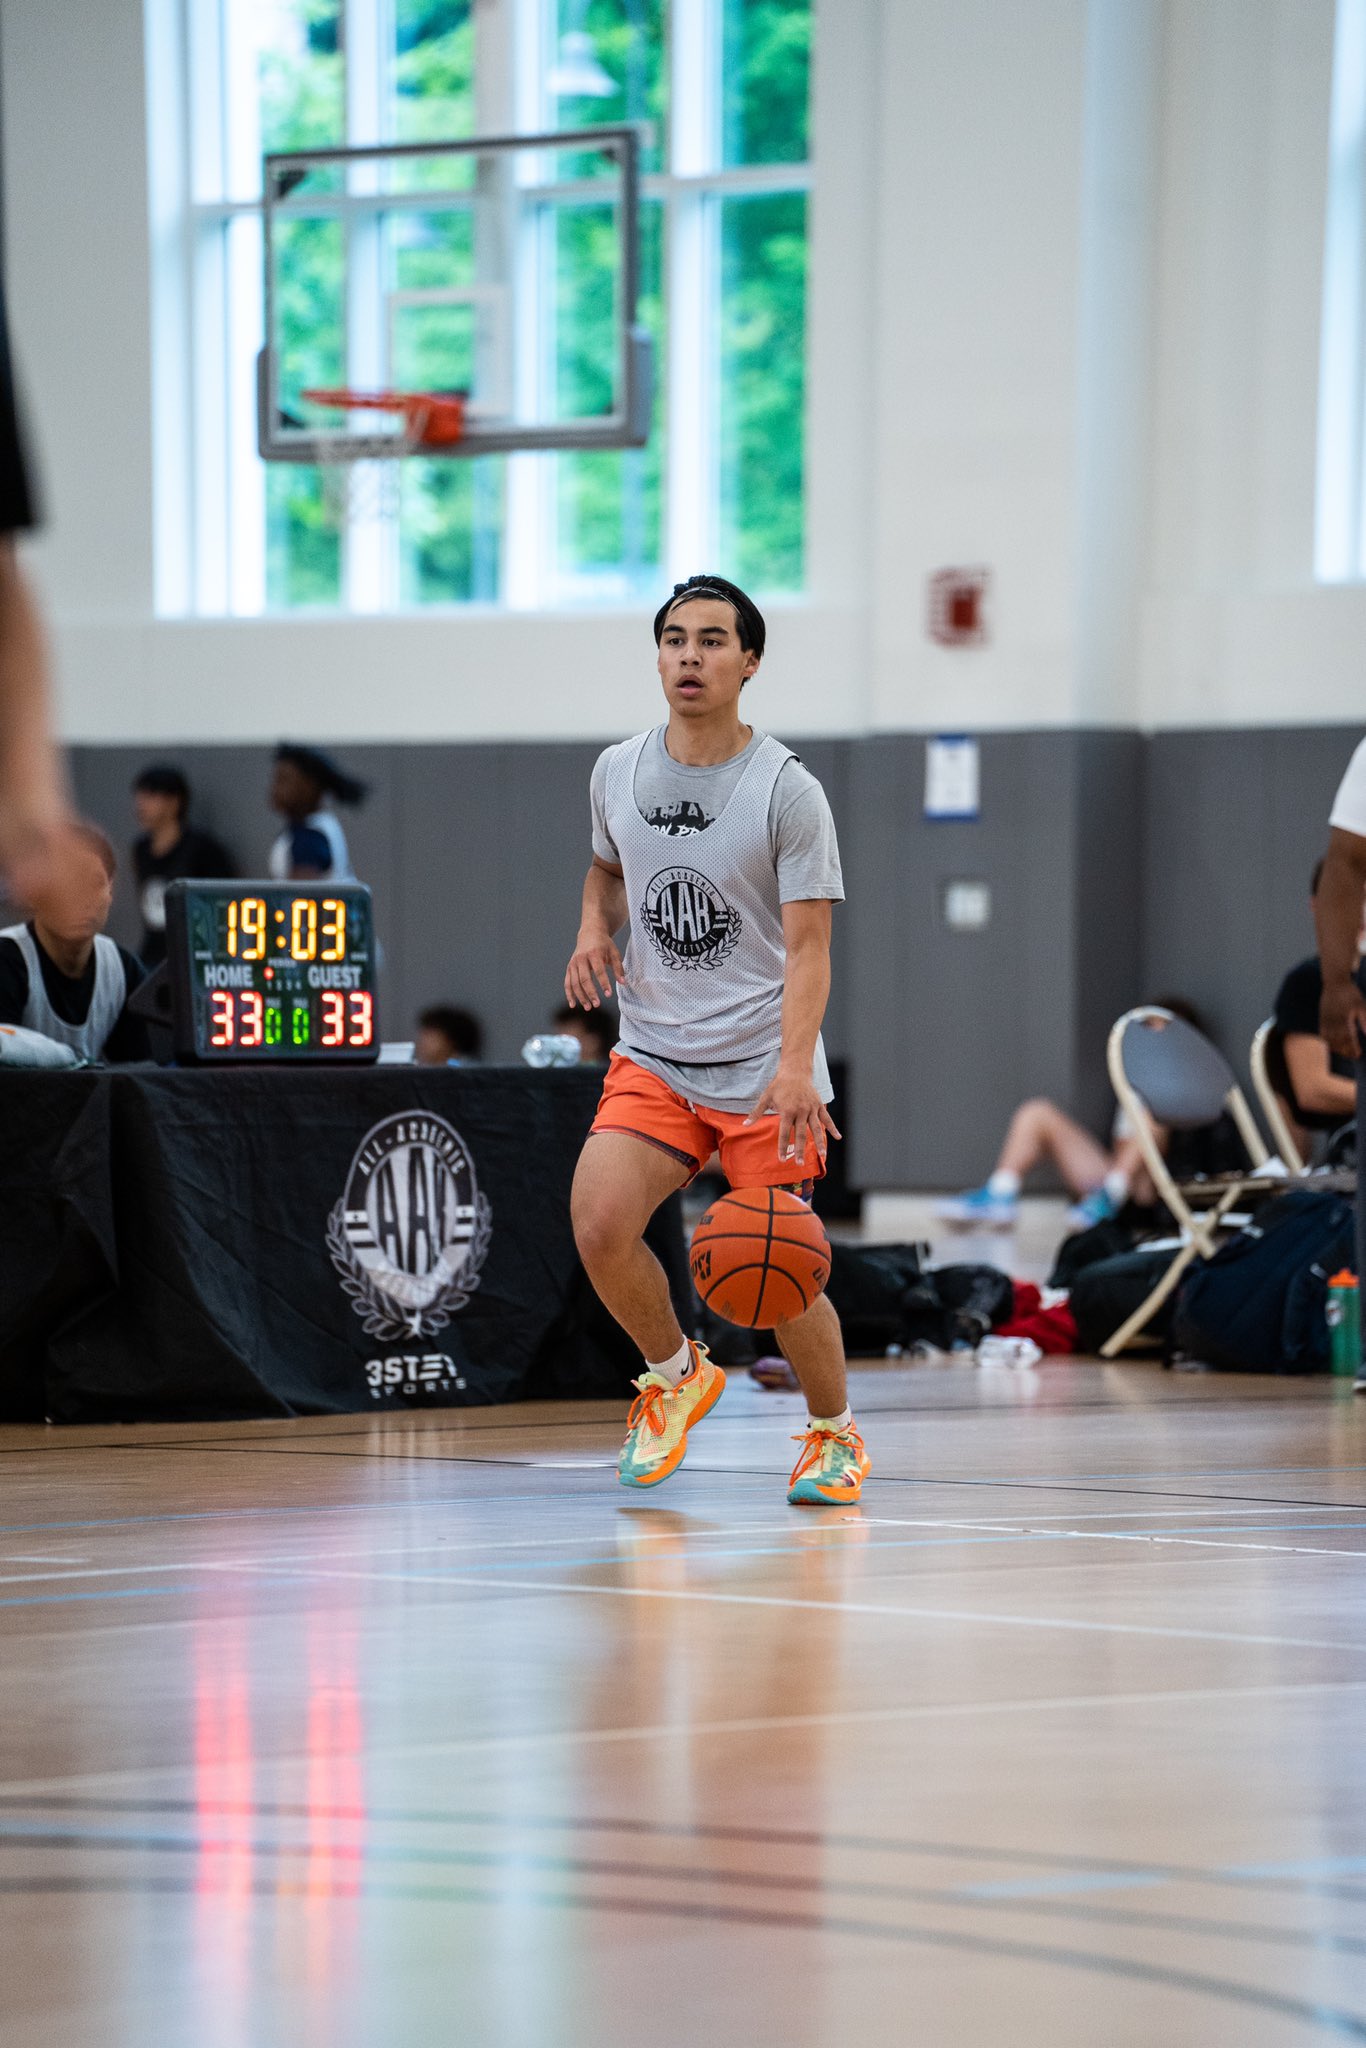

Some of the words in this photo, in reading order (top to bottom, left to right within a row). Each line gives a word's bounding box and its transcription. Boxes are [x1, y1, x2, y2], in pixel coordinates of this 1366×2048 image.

[227, 898, 346, 960] 19:03
[660, 881, 711, 943] AAB
[659, 932, 718, 954] BASKETBALL
[204, 964, 253, 988] HOME
[307, 964, 362, 988] GUEST
[211, 991, 264, 1046] 33
[321, 991, 373, 1046] 33
[370, 1377, 467, 1399] SPORTS
